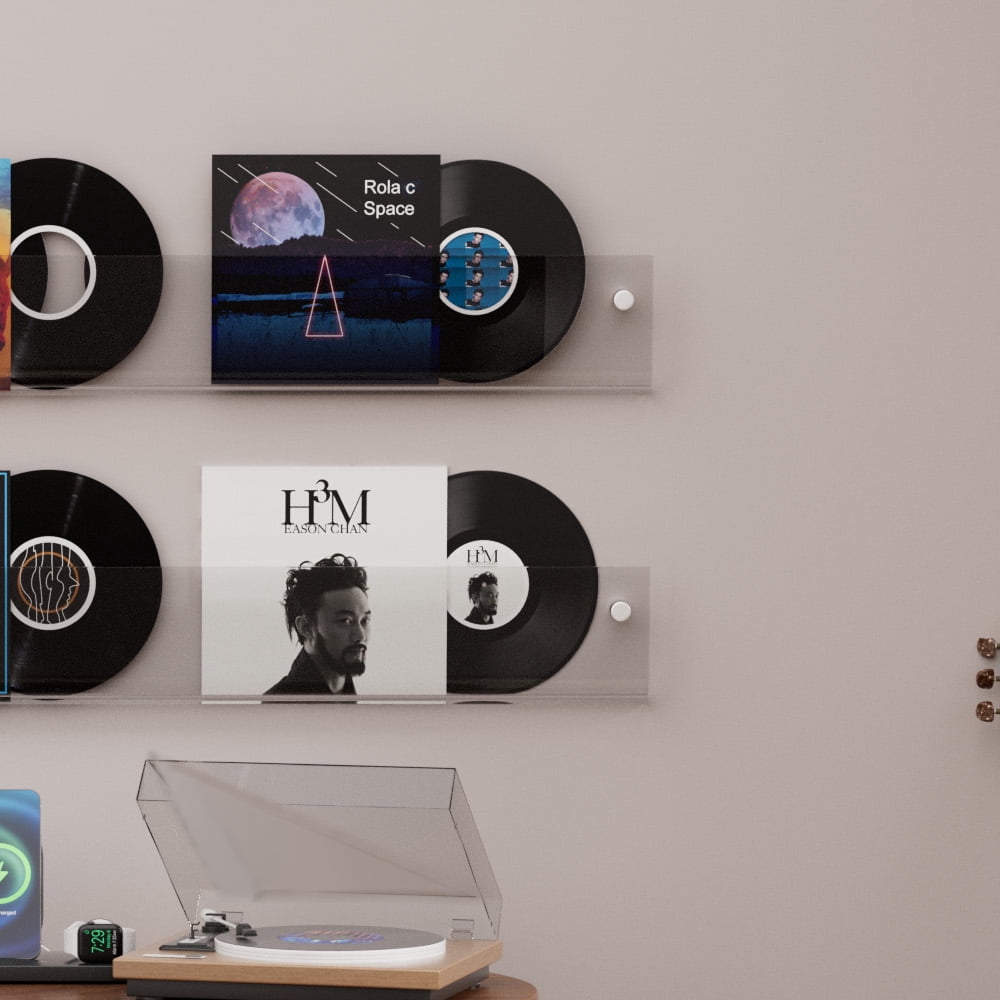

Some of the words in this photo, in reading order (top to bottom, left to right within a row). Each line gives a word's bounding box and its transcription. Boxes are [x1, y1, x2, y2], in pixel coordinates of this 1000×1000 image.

[364, 179, 400, 194] Rola
[405, 182, 416, 194] c
[363, 200, 415, 219] Space
[285, 524, 327, 534] EASON
[330, 524, 368, 534] CHAN
[91, 930, 105, 953] 7:29
